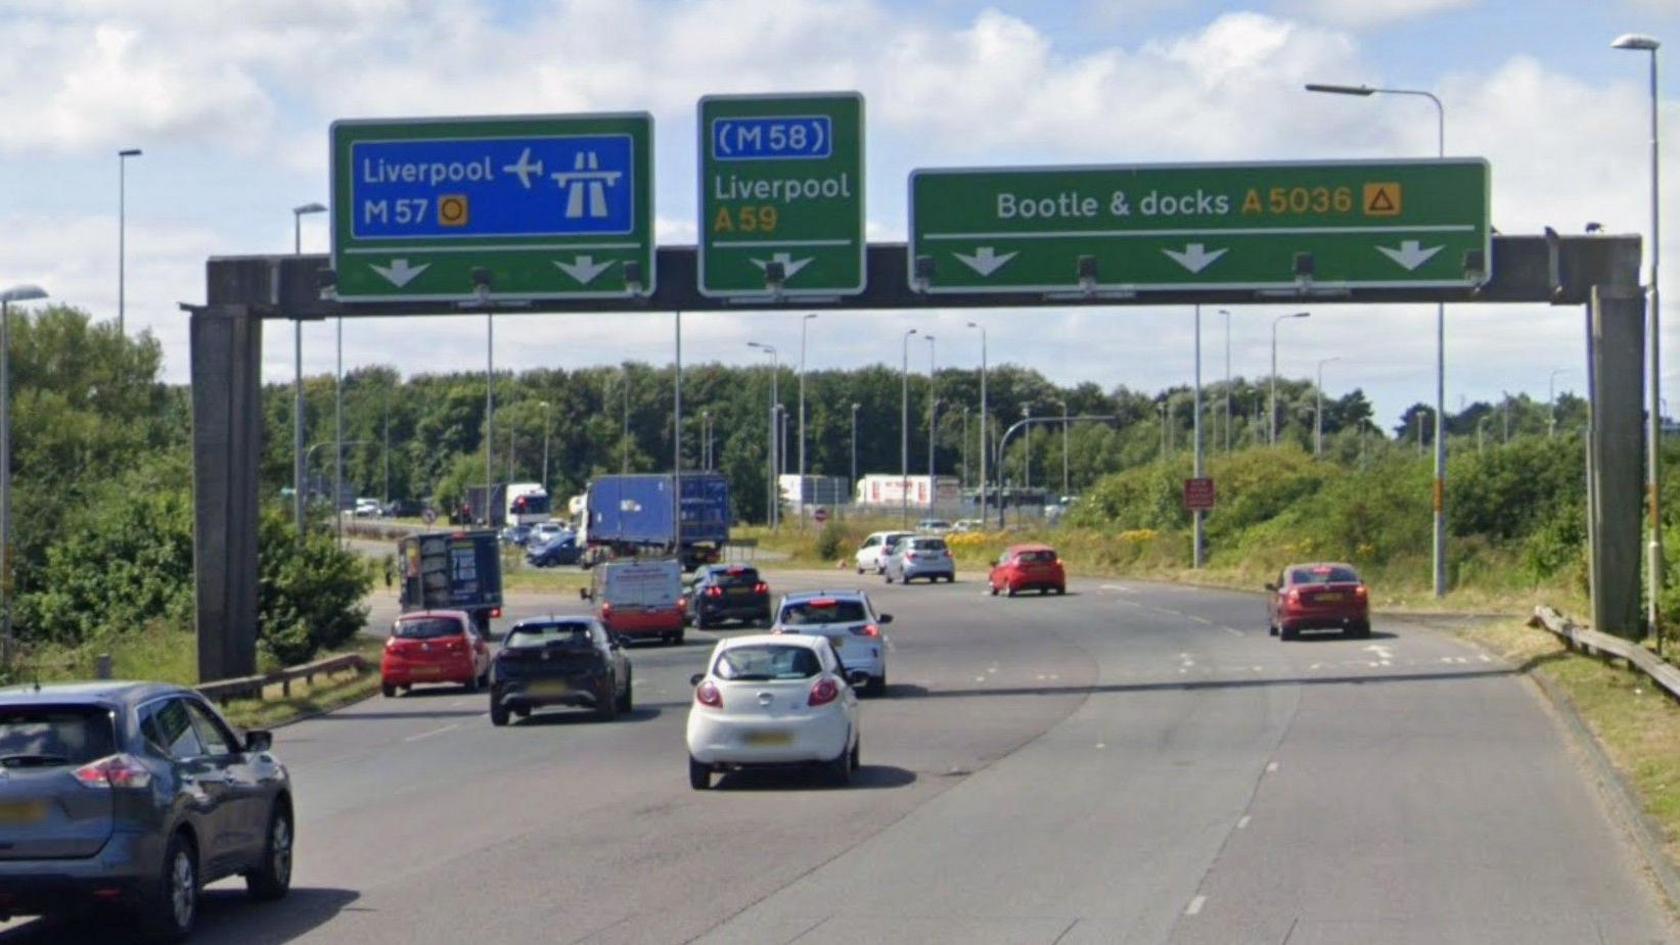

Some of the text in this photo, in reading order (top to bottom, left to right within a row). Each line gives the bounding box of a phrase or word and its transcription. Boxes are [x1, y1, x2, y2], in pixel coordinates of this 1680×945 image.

[363, 156, 494, 186] Liverpool
[715, 173, 851, 204] Liverpool
[997, 191, 1099, 218] Bootle
[1110, 190, 1130, 216] &
[1140, 189, 1229, 215] docks
